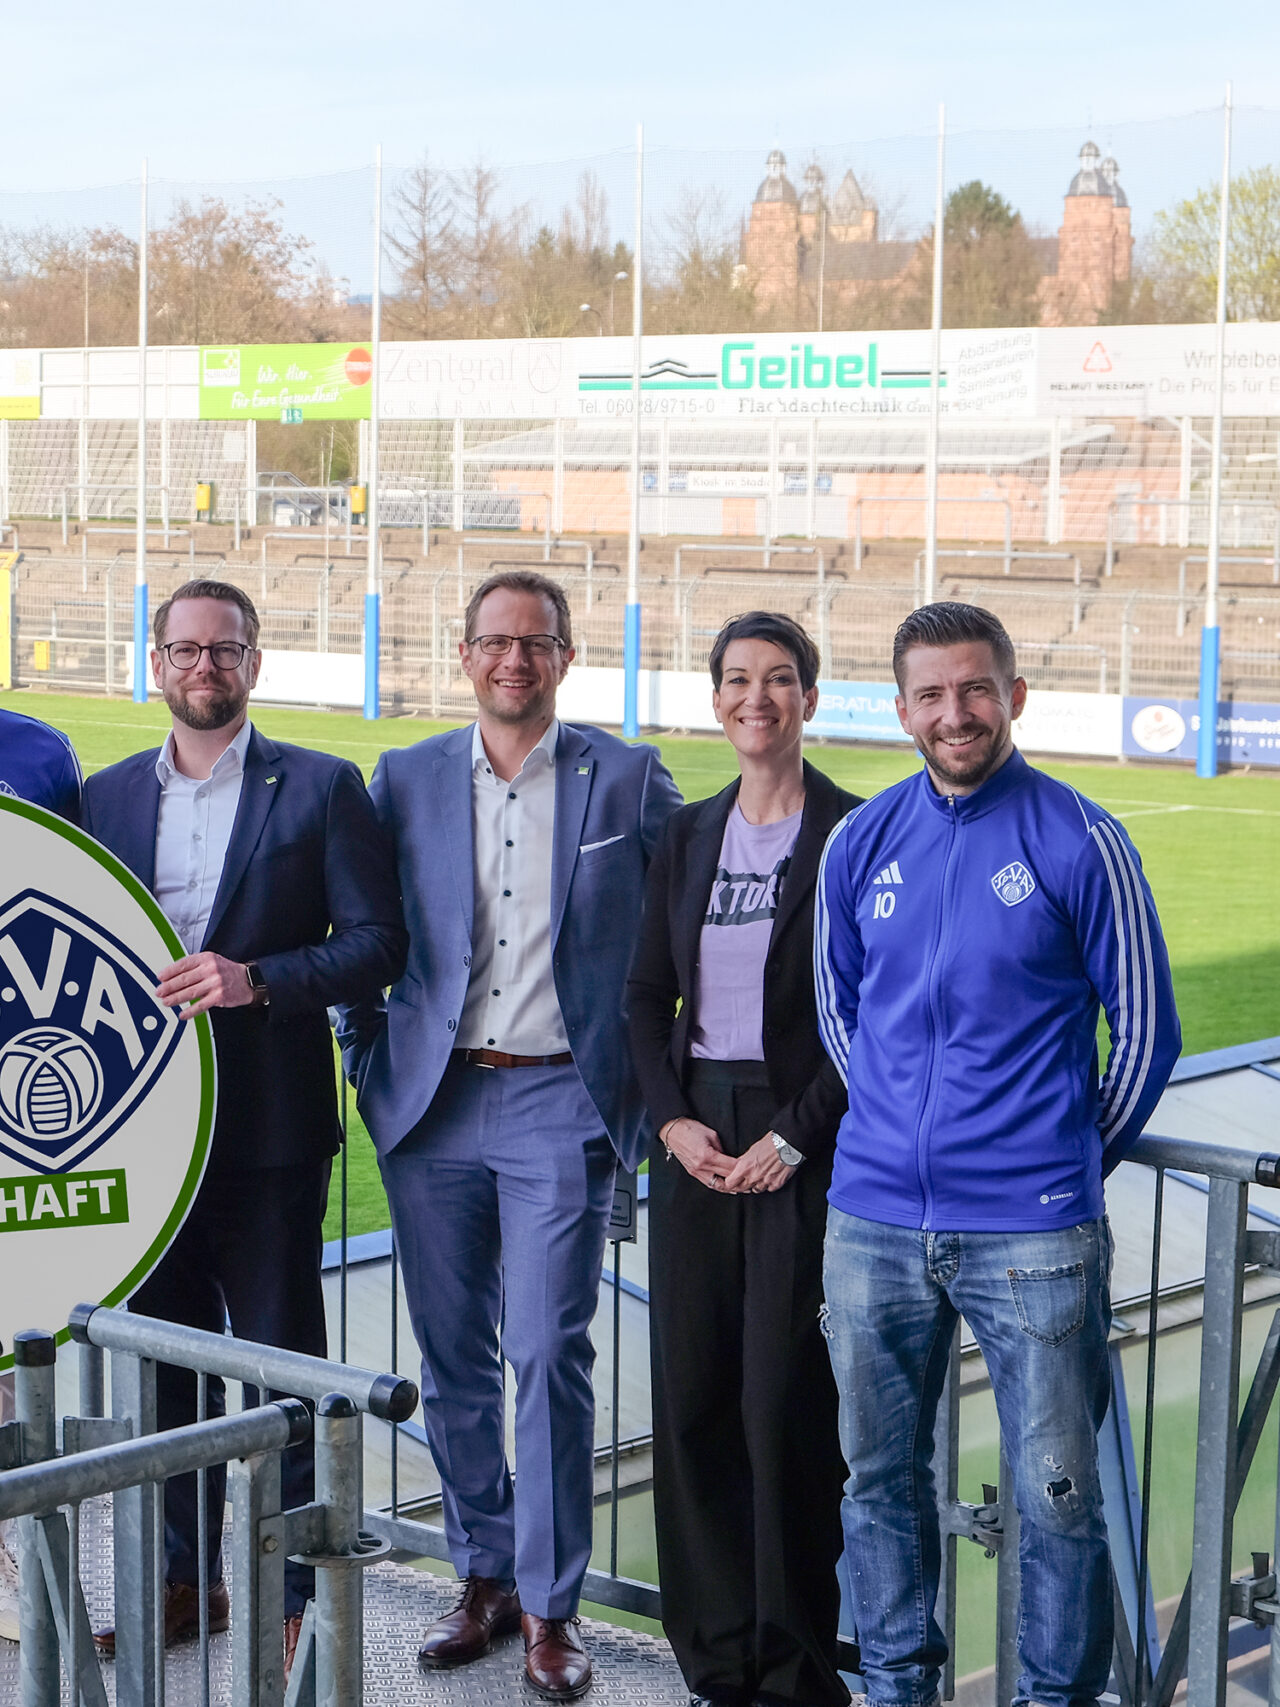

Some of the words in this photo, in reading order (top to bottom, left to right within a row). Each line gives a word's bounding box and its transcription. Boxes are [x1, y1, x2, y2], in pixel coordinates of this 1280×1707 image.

[383, 343, 523, 395] Zentgraf
[720, 340, 880, 390] Geibel
[1183, 349, 1216, 369] Wir
[958, 368, 1023, 394] Sanierung
[1049, 382, 1091, 391] HELMUT
[1159, 376, 1185, 393] Die
[1191, 376, 1237, 393] Prois
[1241, 375, 1264, 393] für
[577, 398, 600, 414] Tel.
[738, 396, 903, 414] Flachdachtechnik
[692, 477, 720, 488] Kiosk
[819, 693, 896, 713] ERATUN
[872, 891, 897, 920] 10
